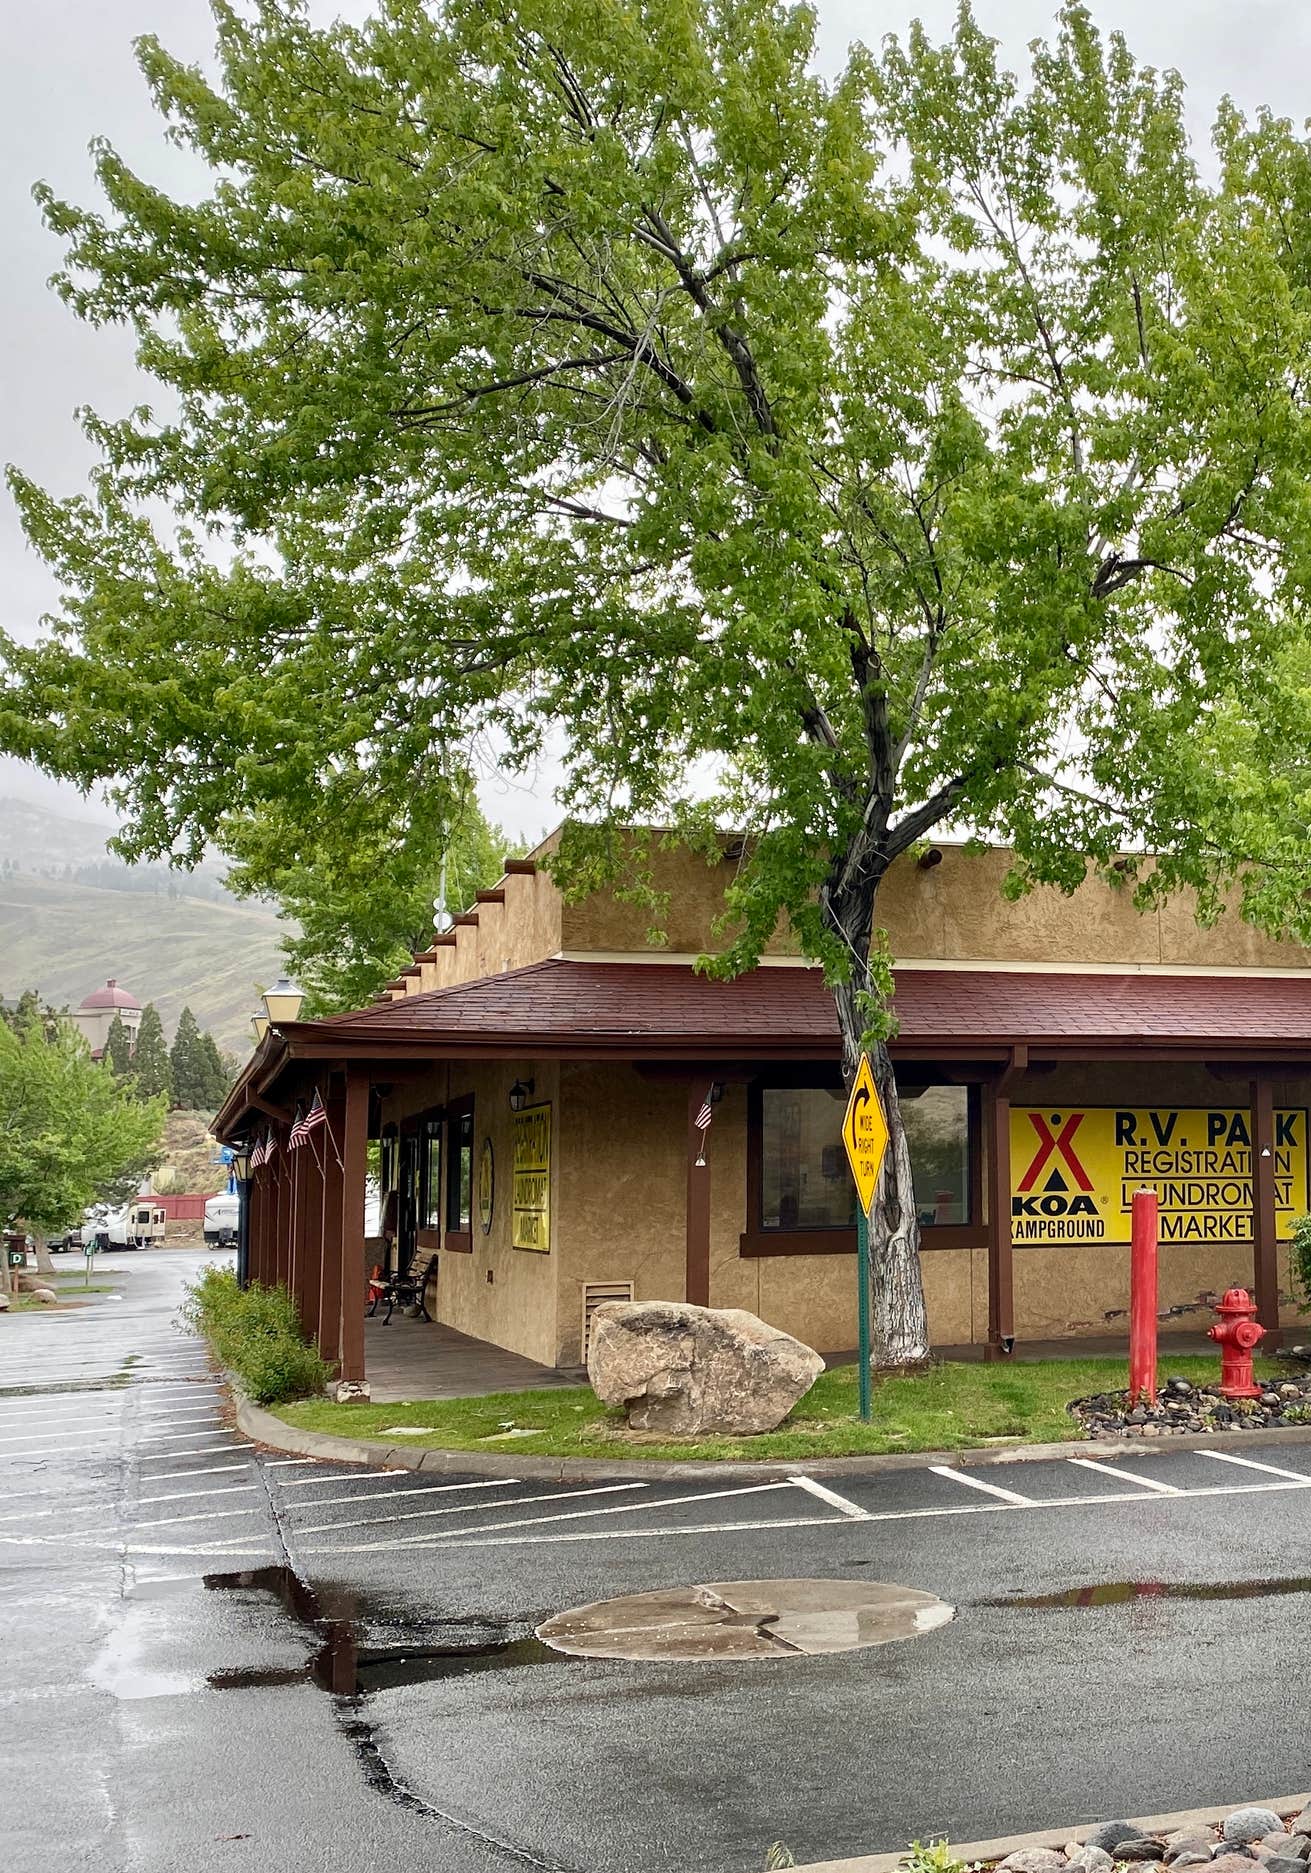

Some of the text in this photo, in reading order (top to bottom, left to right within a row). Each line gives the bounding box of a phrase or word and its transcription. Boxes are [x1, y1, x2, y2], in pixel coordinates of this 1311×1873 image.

[860, 1115, 873, 1131] WIDE
[1115, 1112, 1297, 1147] R.V. PAK
[858, 1138, 874, 1154] RIGHT
[860, 1161, 874, 1177] TURN
[1125, 1151, 1290, 1173] REGISTRATIN
[1122, 1182, 1293, 1206] LUNDROAT
[1012, 1195, 1099, 1216] KOA
[1161, 1215, 1254, 1238] MARKET
[12, 1254, 21, 1264] D
